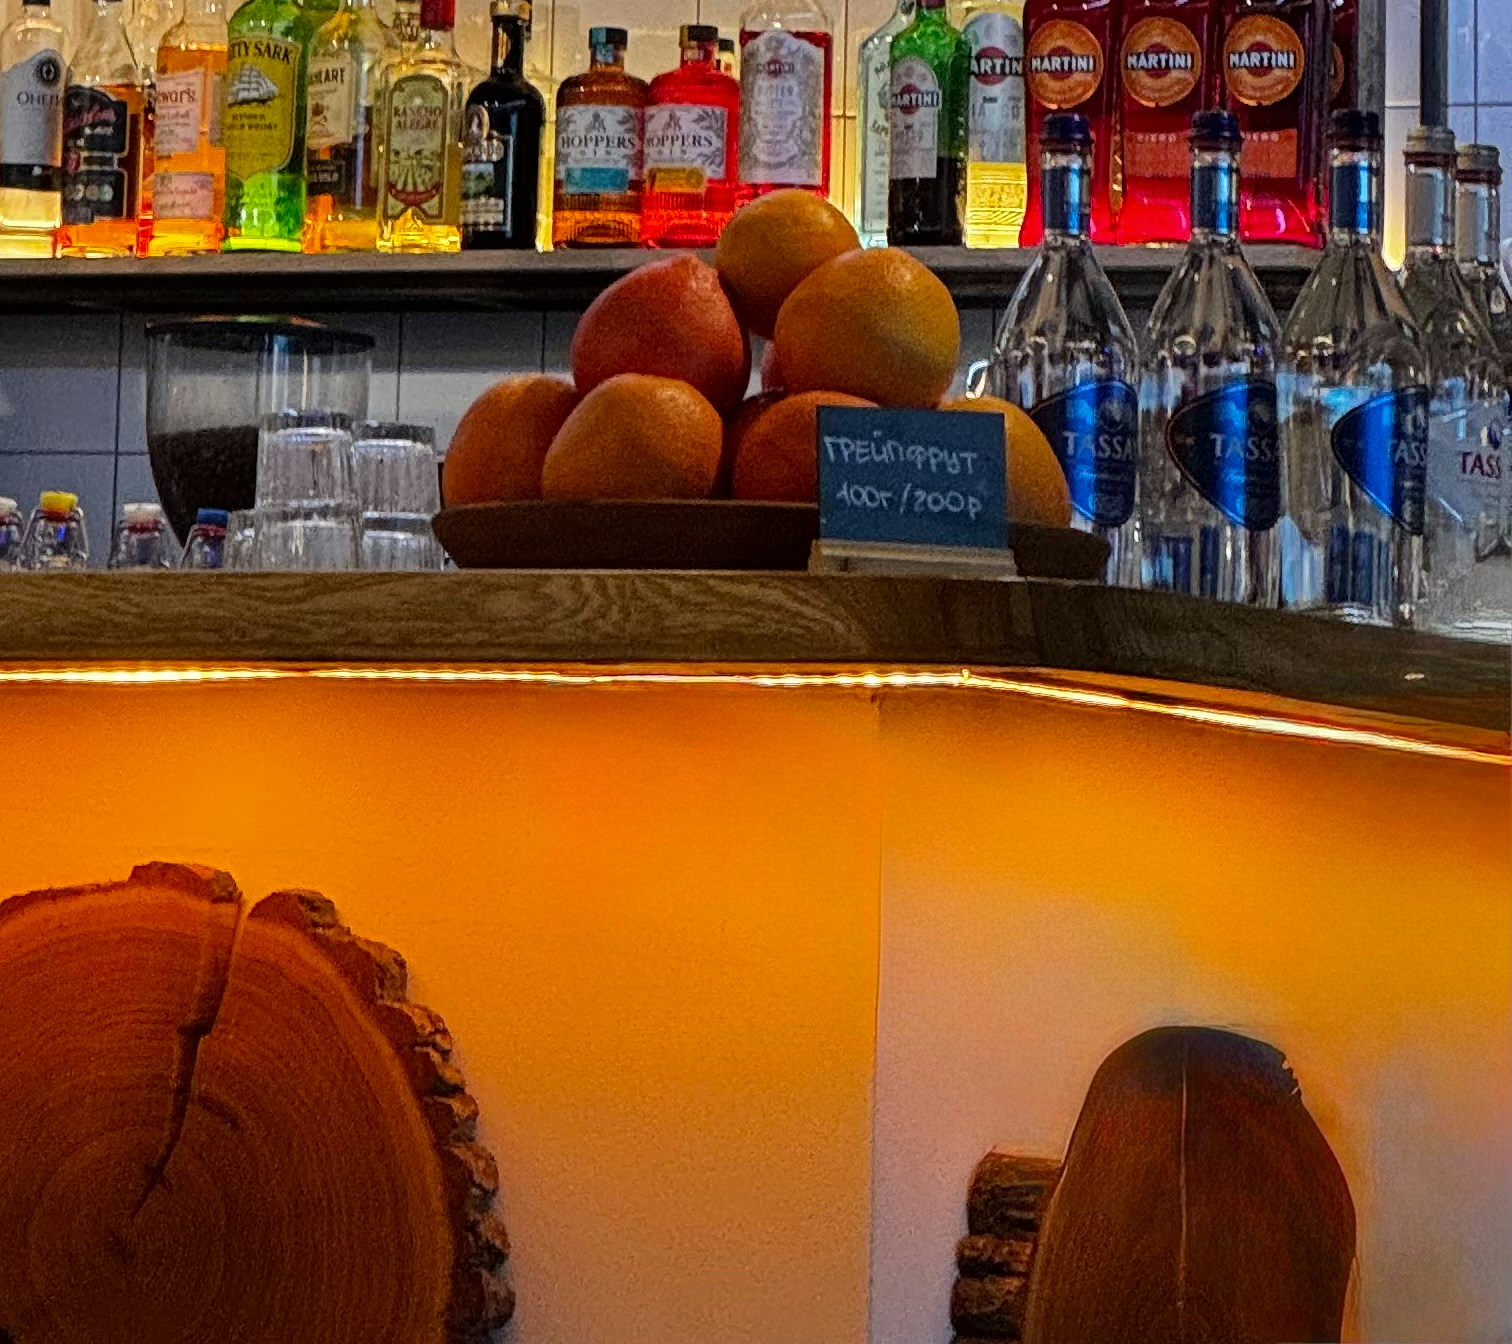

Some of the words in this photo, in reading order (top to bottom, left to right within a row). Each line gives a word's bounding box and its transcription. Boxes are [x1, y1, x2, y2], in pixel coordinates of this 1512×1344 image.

[254, 41, 294, 64] SARK
[1127, 52, 1192, 70] MARTINI
[1229, 51, 1295, 69] MARTINI
[1031, 55, 1094, 73] MARTINI
[561, 135, 636, 150] HOPPERS
